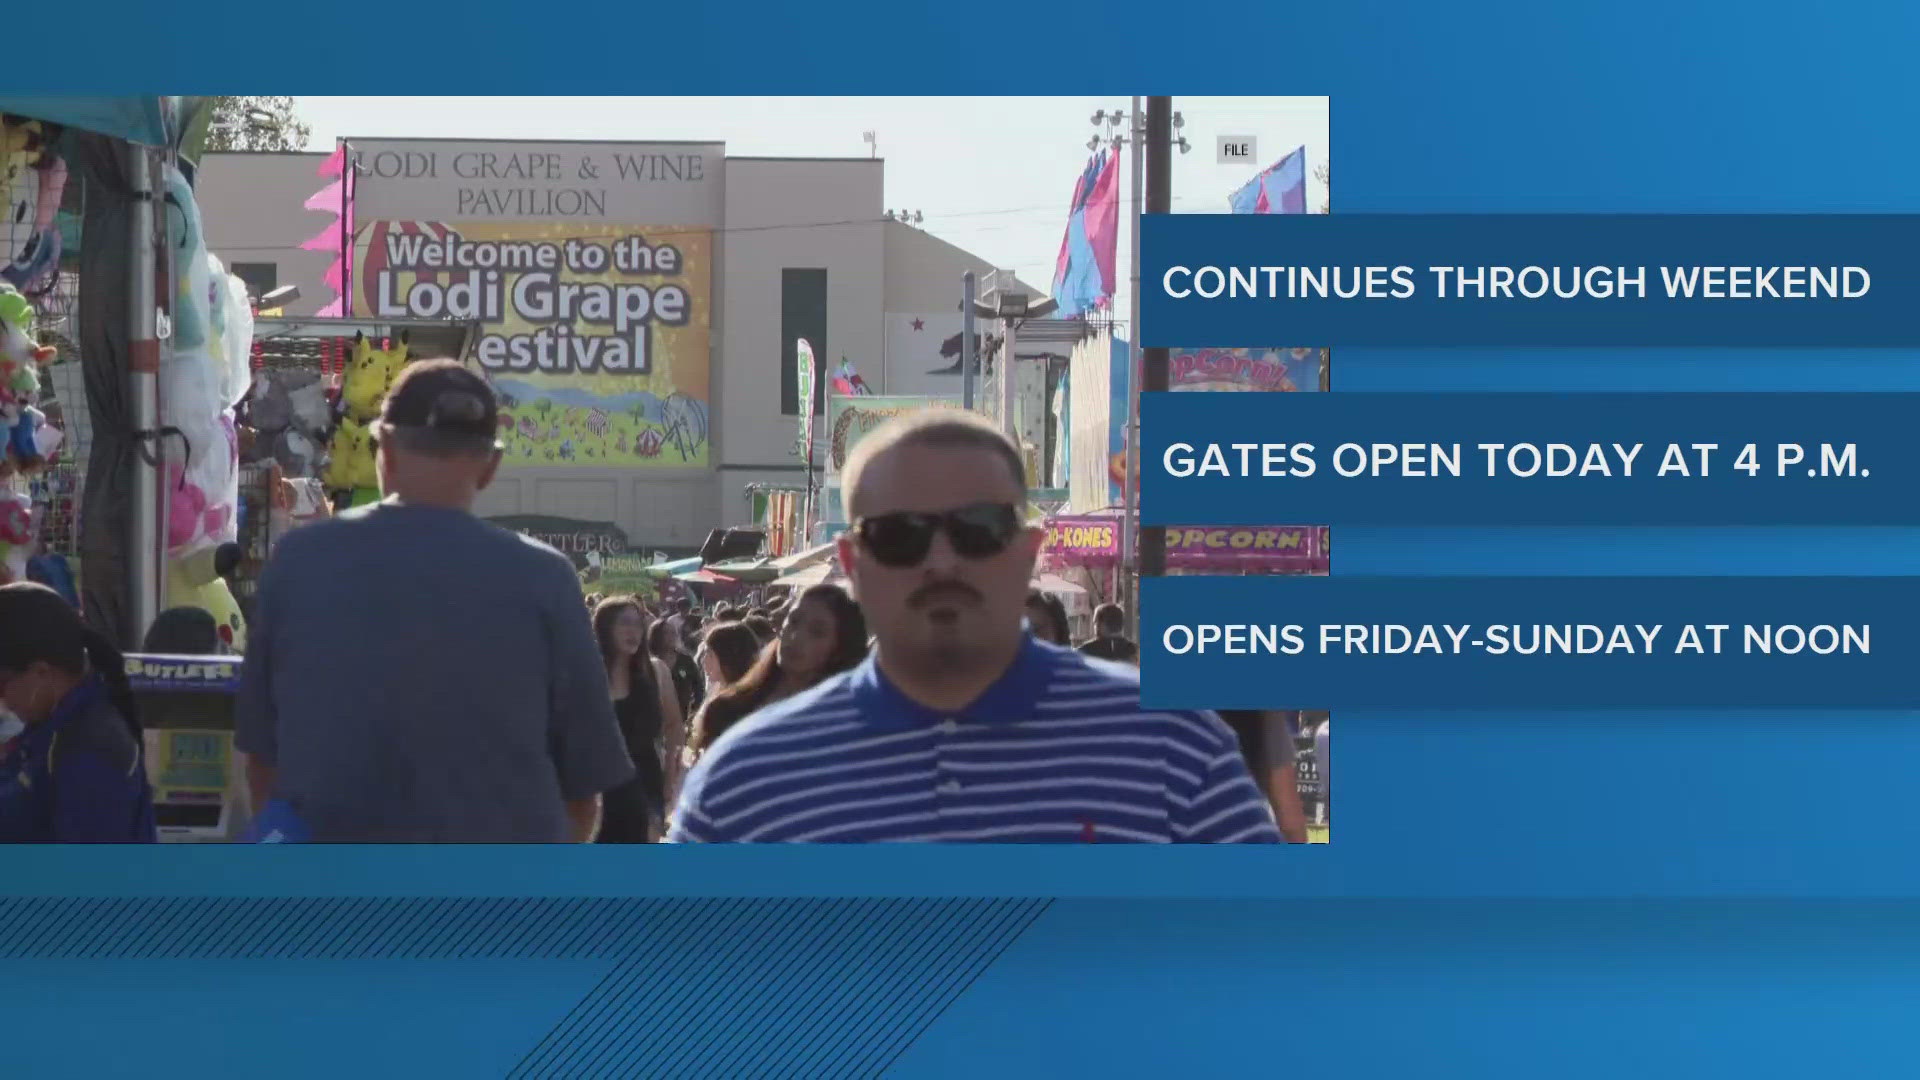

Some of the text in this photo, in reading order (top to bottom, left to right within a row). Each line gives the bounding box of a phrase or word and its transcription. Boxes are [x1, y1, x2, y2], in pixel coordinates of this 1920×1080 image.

[355, 151, 704, 181] LODI GRAPE & WINE
[457, 188, 607, 216] PAVILION
[386, 233, 676, 270] Welcome to the
[379, 269, 685, 333] Lodi Grape
[478, 324, 646, 370] estival
[1048, 527, 1113, 548] O-KONES
[1166, 529, 1301, 550] OPCORN
